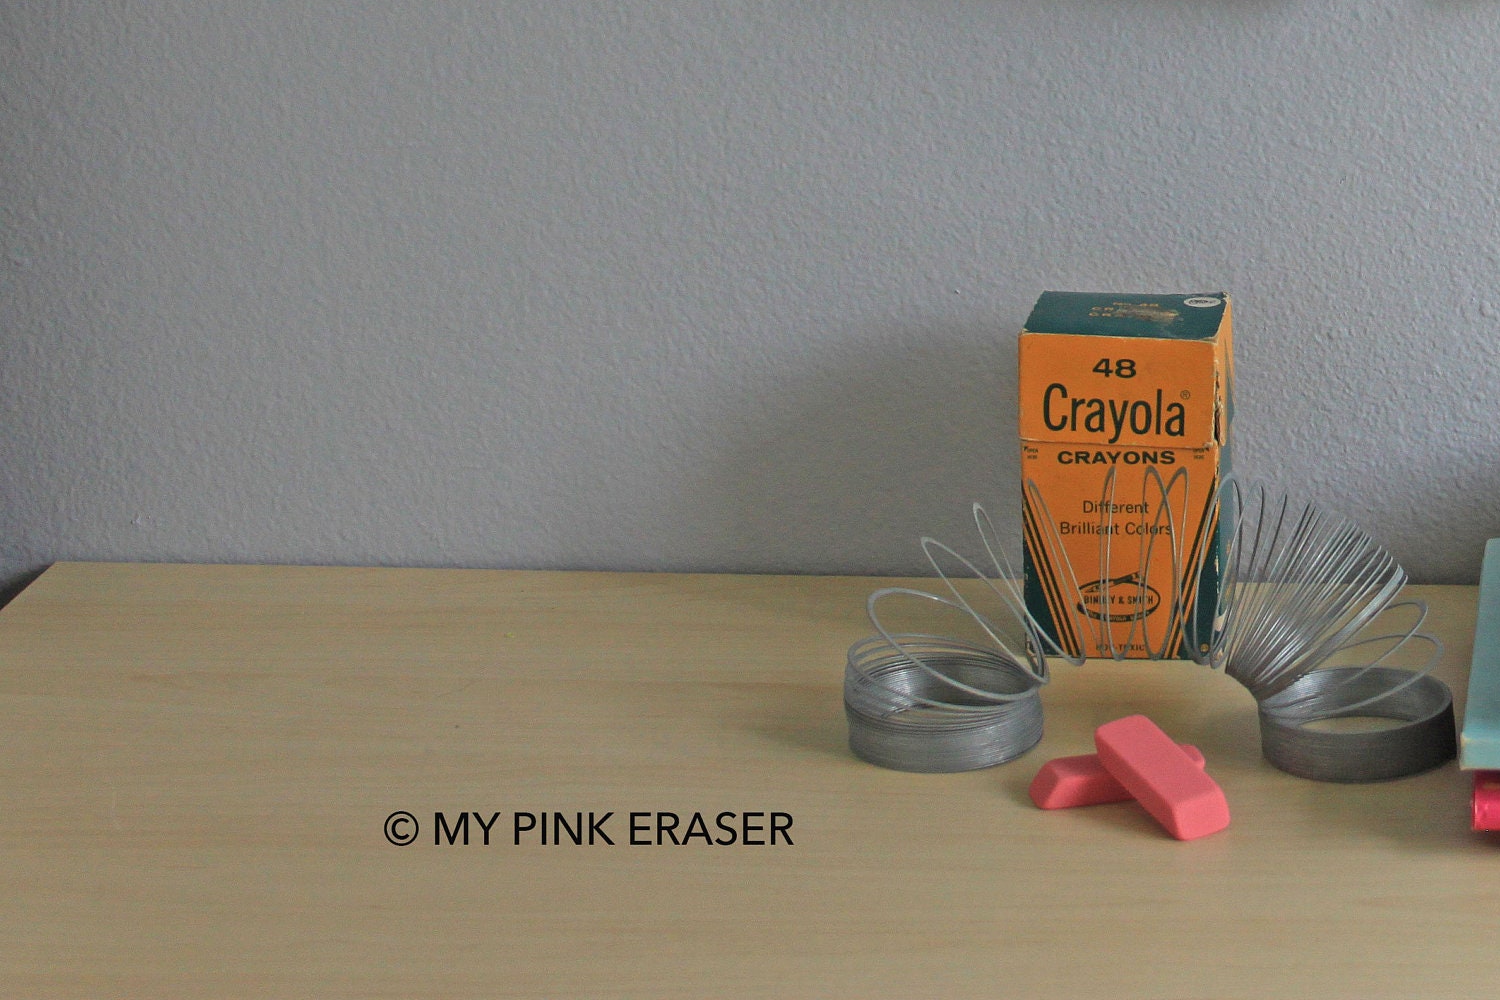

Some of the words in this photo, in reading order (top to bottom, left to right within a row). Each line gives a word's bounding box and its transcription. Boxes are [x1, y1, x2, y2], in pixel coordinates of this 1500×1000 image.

[1092, 358, 1137, 379] 48
[1057, 450, 1176, 466] CRAYONS
[1082, 500, 1149, 514] Different
[1060, 521, 1120, 536] Brilliant
[1125, 522, 1173, 536] Colors
